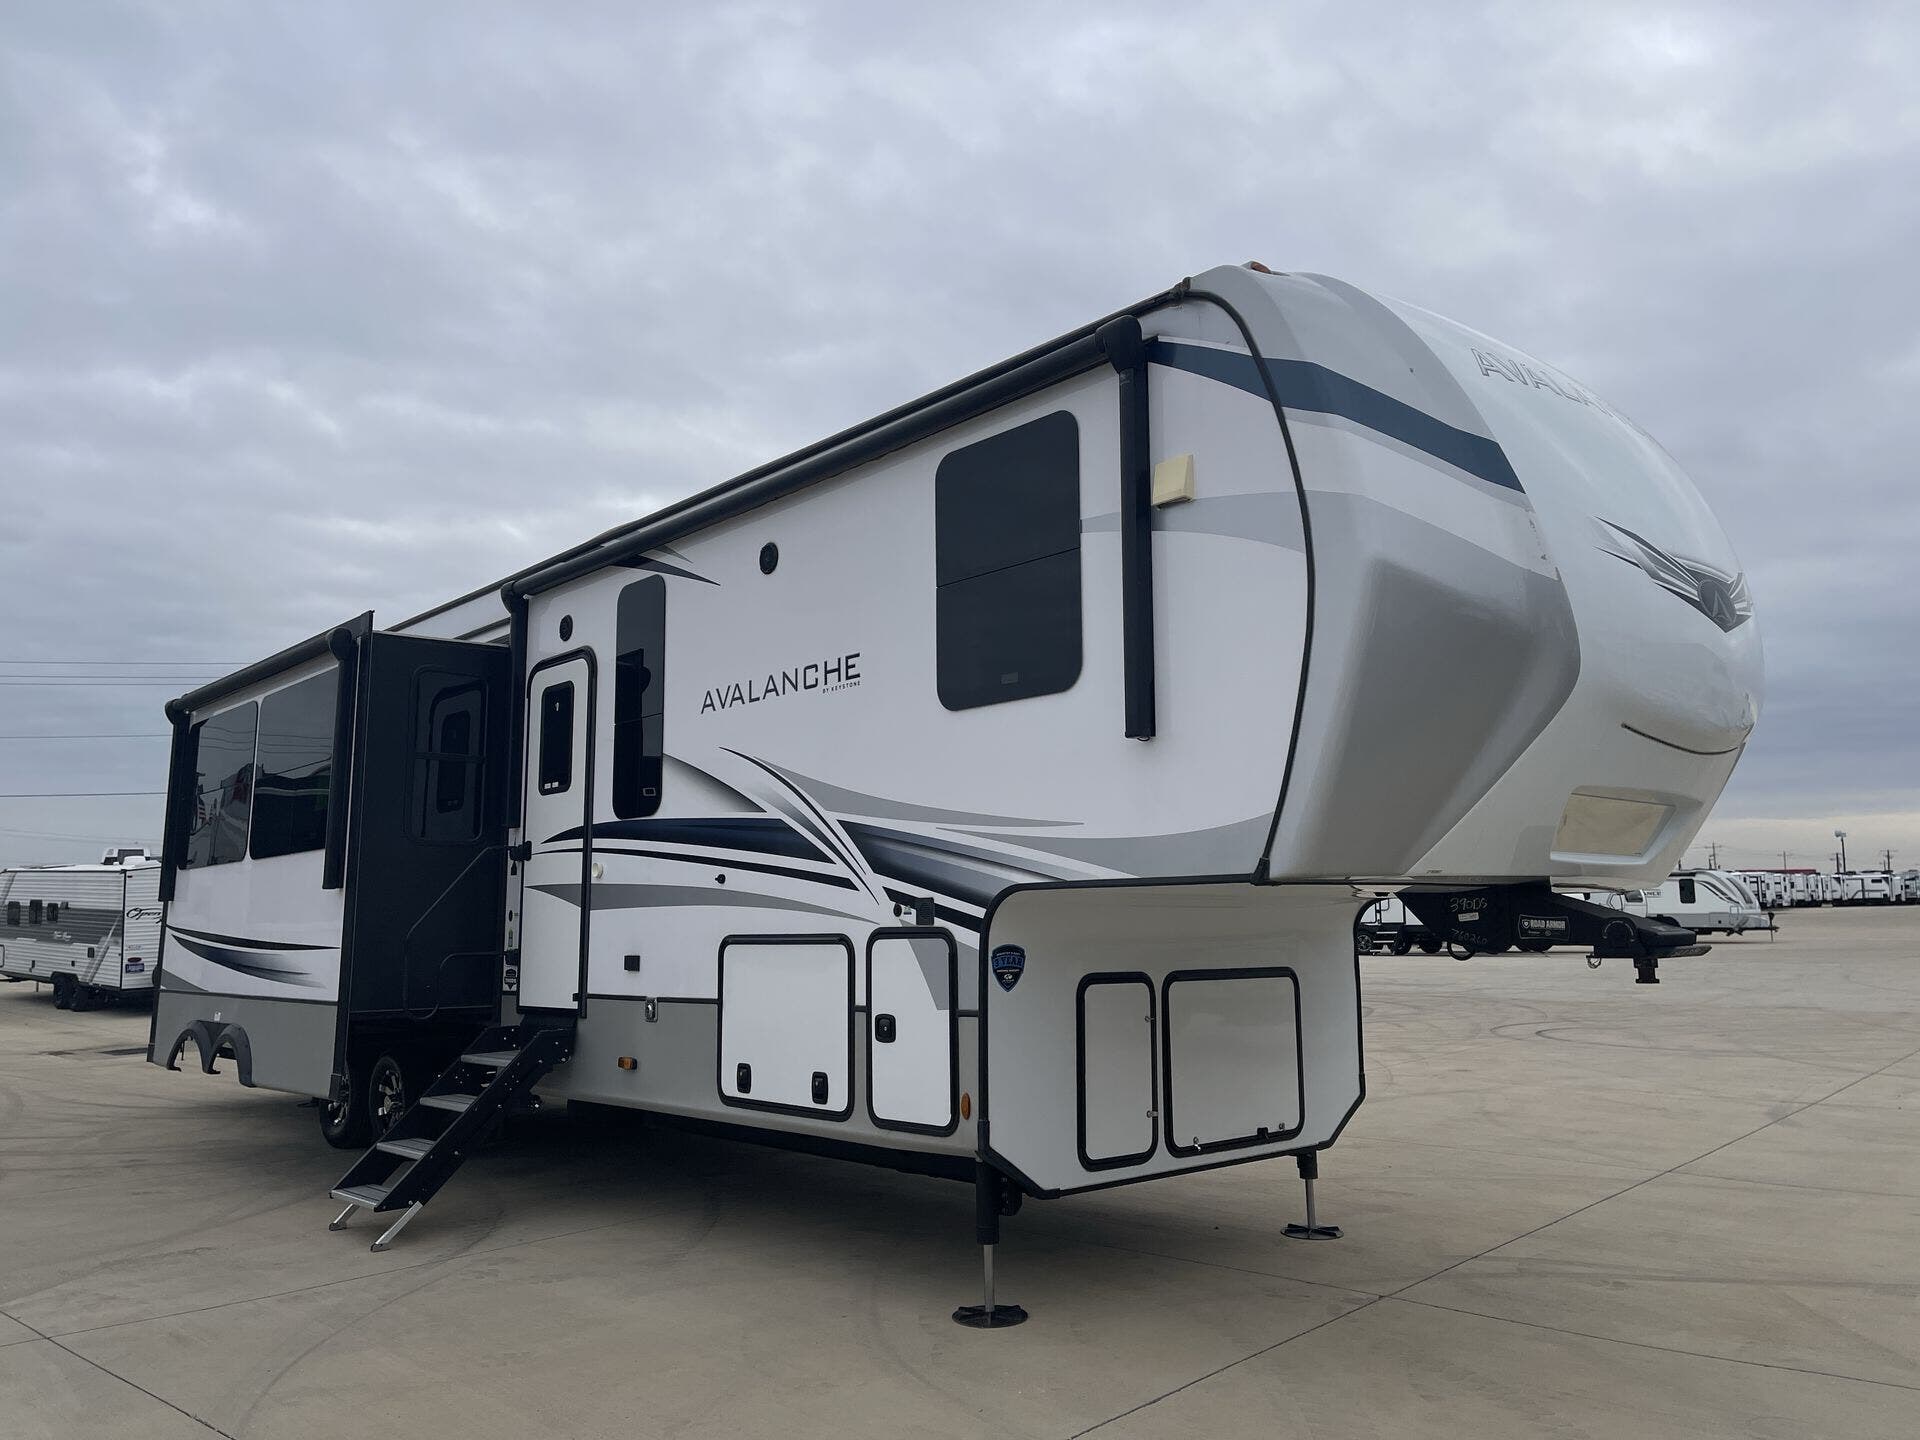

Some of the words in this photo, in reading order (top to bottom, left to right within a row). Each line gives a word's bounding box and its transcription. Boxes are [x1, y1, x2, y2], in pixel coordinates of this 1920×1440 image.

[700, 652, 861, 715] AVALANCHE
[831, 681, 861, 692] KEYSTONE
[1530, 919, 1546, 929] ROAD
[1546, 920, 1566, 930] ARMOR
